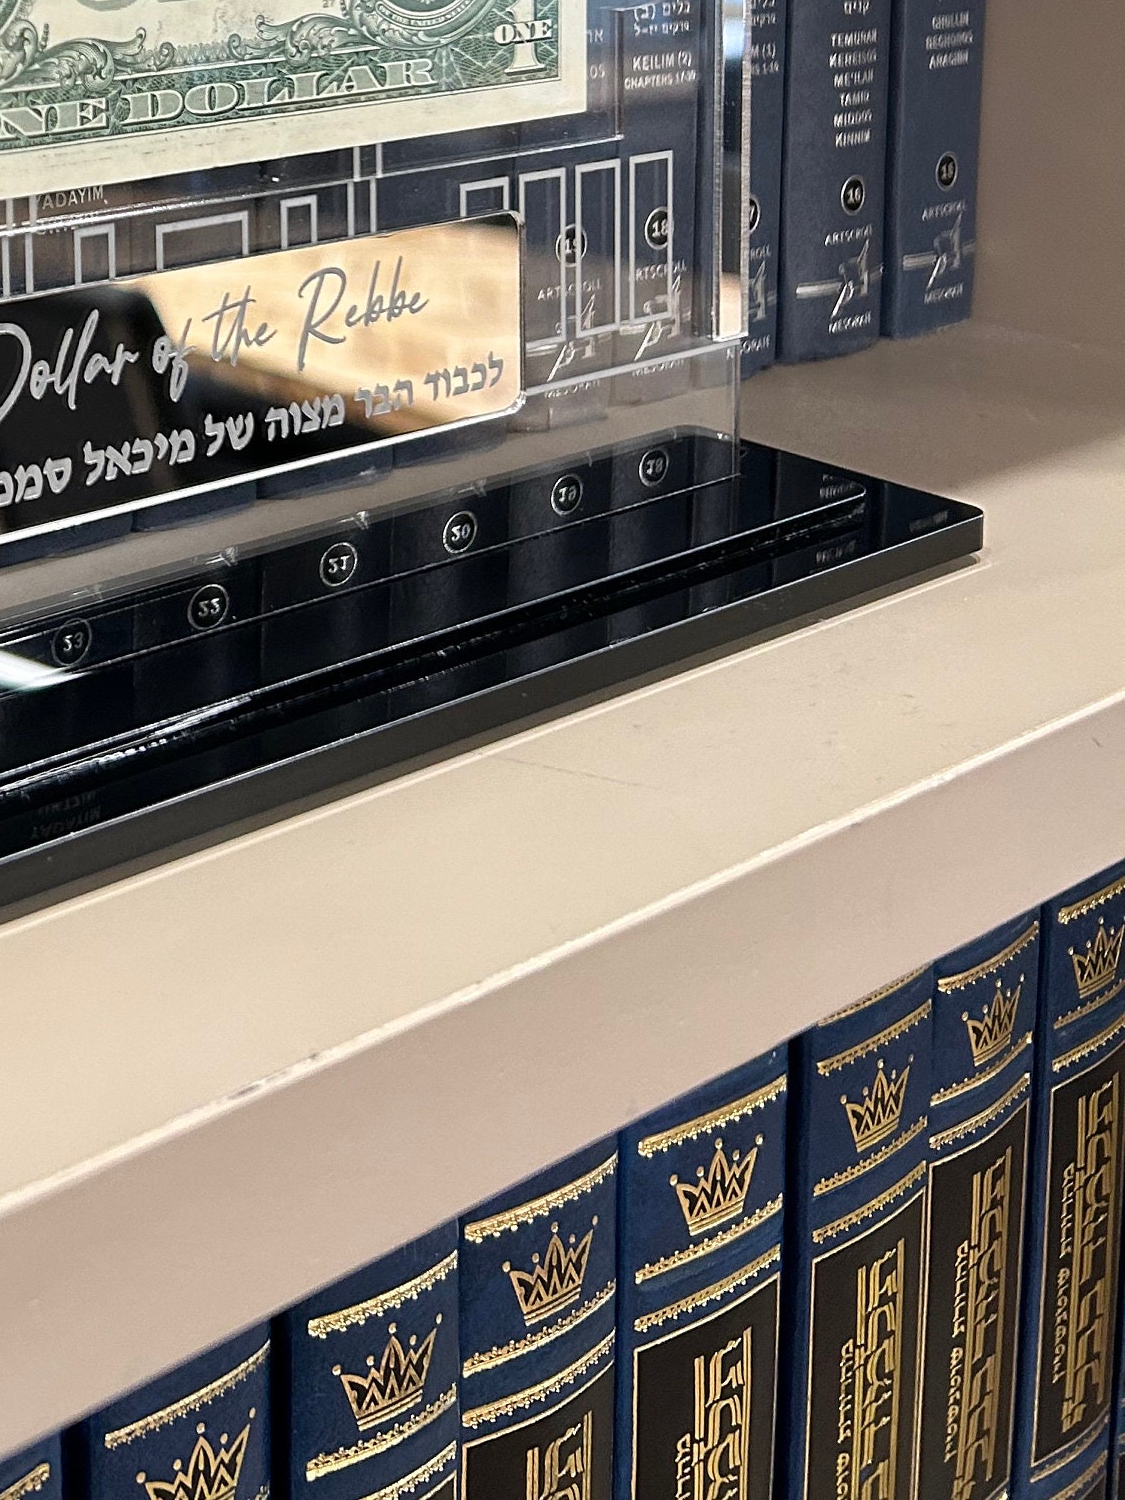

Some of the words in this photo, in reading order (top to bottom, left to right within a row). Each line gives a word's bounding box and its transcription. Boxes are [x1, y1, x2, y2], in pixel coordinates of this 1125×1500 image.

[493, 19, 553, 47] ONE
[632, 52, 676, 72] KEILIM
[121, 56, 438, 127] DOLLAR
[151, 317, 198, 403] of
[201, 284, 279, 367] the
[297, 255, 431, 375] Rebbe
[353, 377, 416, 420] הבר
[423, 350, 505, 402] לכבוד
[204, 411, 256, 459] של
[264, 392, 346, 443] מצוה
[83, 427, 197, 488] מיכאל
